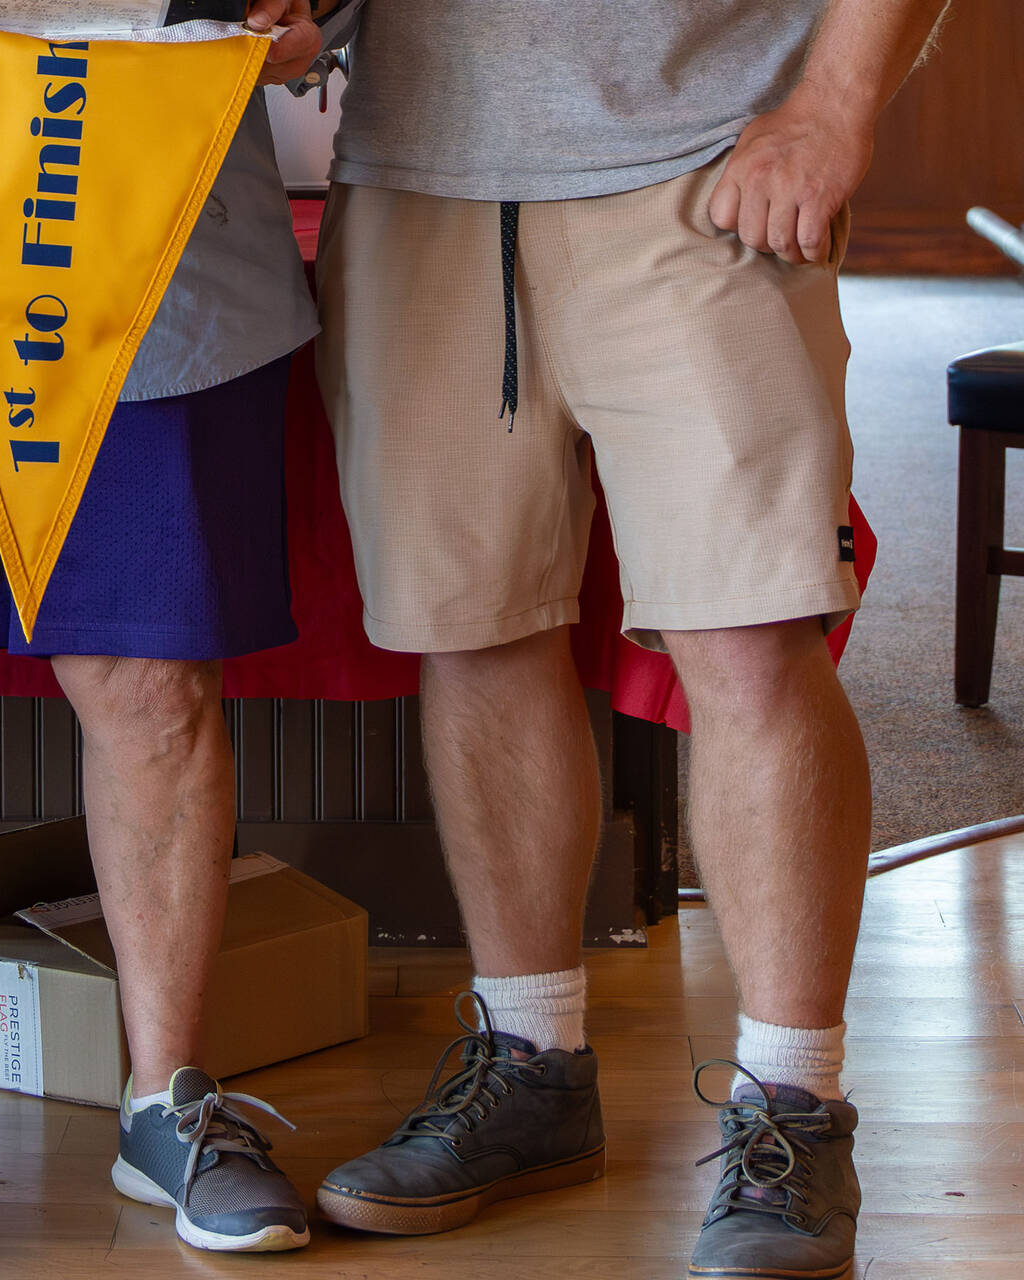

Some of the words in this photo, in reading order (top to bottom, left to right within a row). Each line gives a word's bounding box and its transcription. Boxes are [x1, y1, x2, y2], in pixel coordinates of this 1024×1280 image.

[22, 40, 89, 268] Finish
[13, 294, 68, 366] to
[4, 386, 60, 473] 1st
[8, 995, 22, 1083] PRESTIGE
